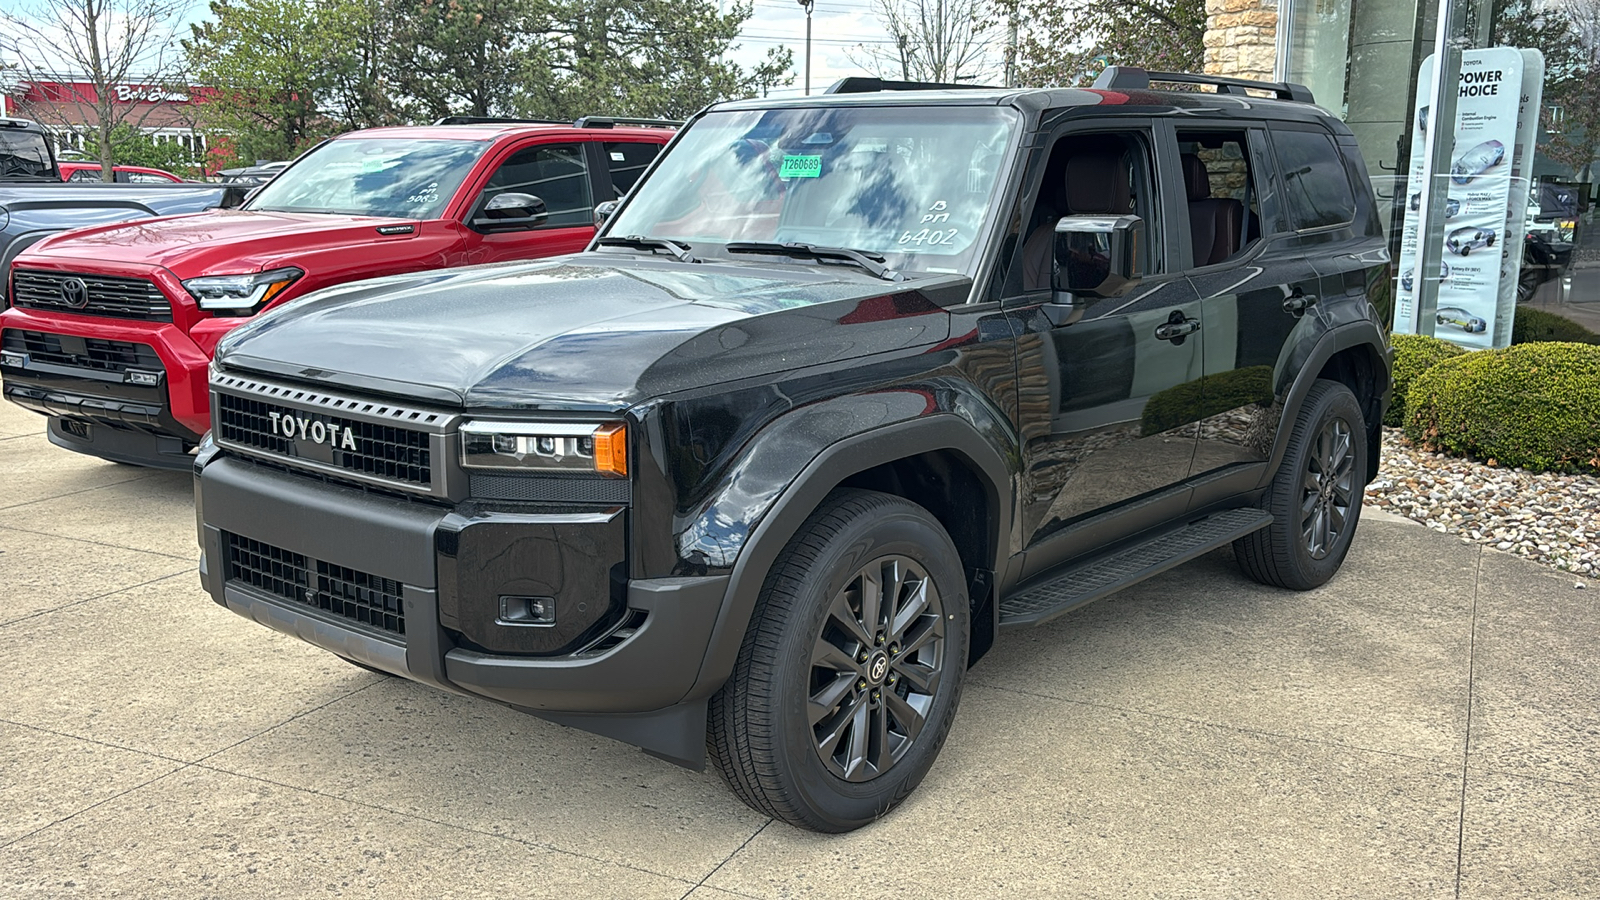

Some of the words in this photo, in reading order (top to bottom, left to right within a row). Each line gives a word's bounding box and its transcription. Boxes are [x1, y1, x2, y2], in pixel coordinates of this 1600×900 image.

[1459, 70, 1503, 84] POWER
[784, 158, 819, 170] T260689
[898, 228, 958, 246] 6402
[268, 411, 357, 451] TOYOTA
